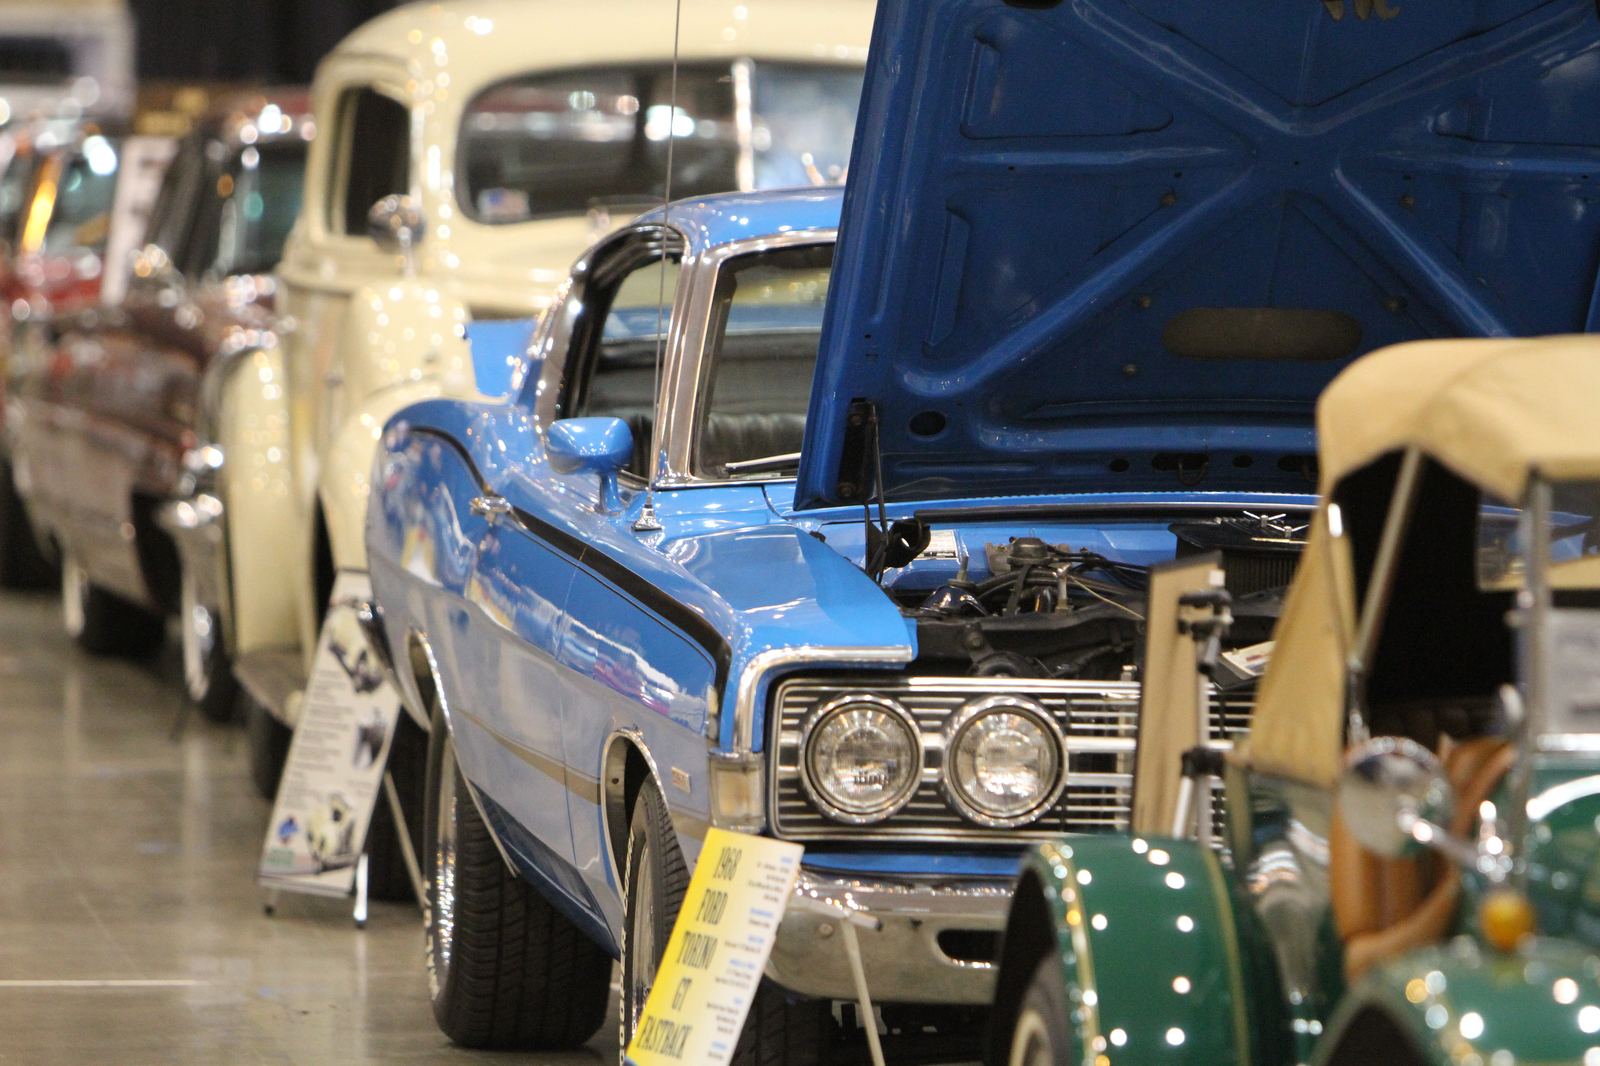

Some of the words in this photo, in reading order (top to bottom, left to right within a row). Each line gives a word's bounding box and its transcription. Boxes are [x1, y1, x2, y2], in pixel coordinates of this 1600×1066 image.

[713, 846, 742, 881] 1968
[696, 888, 728, 925] FORD
[676, 930, 718, 970] TORINO
[672, 977, 693, 1012] GT
[636, 1015, 693, 1060] FASTBACK
